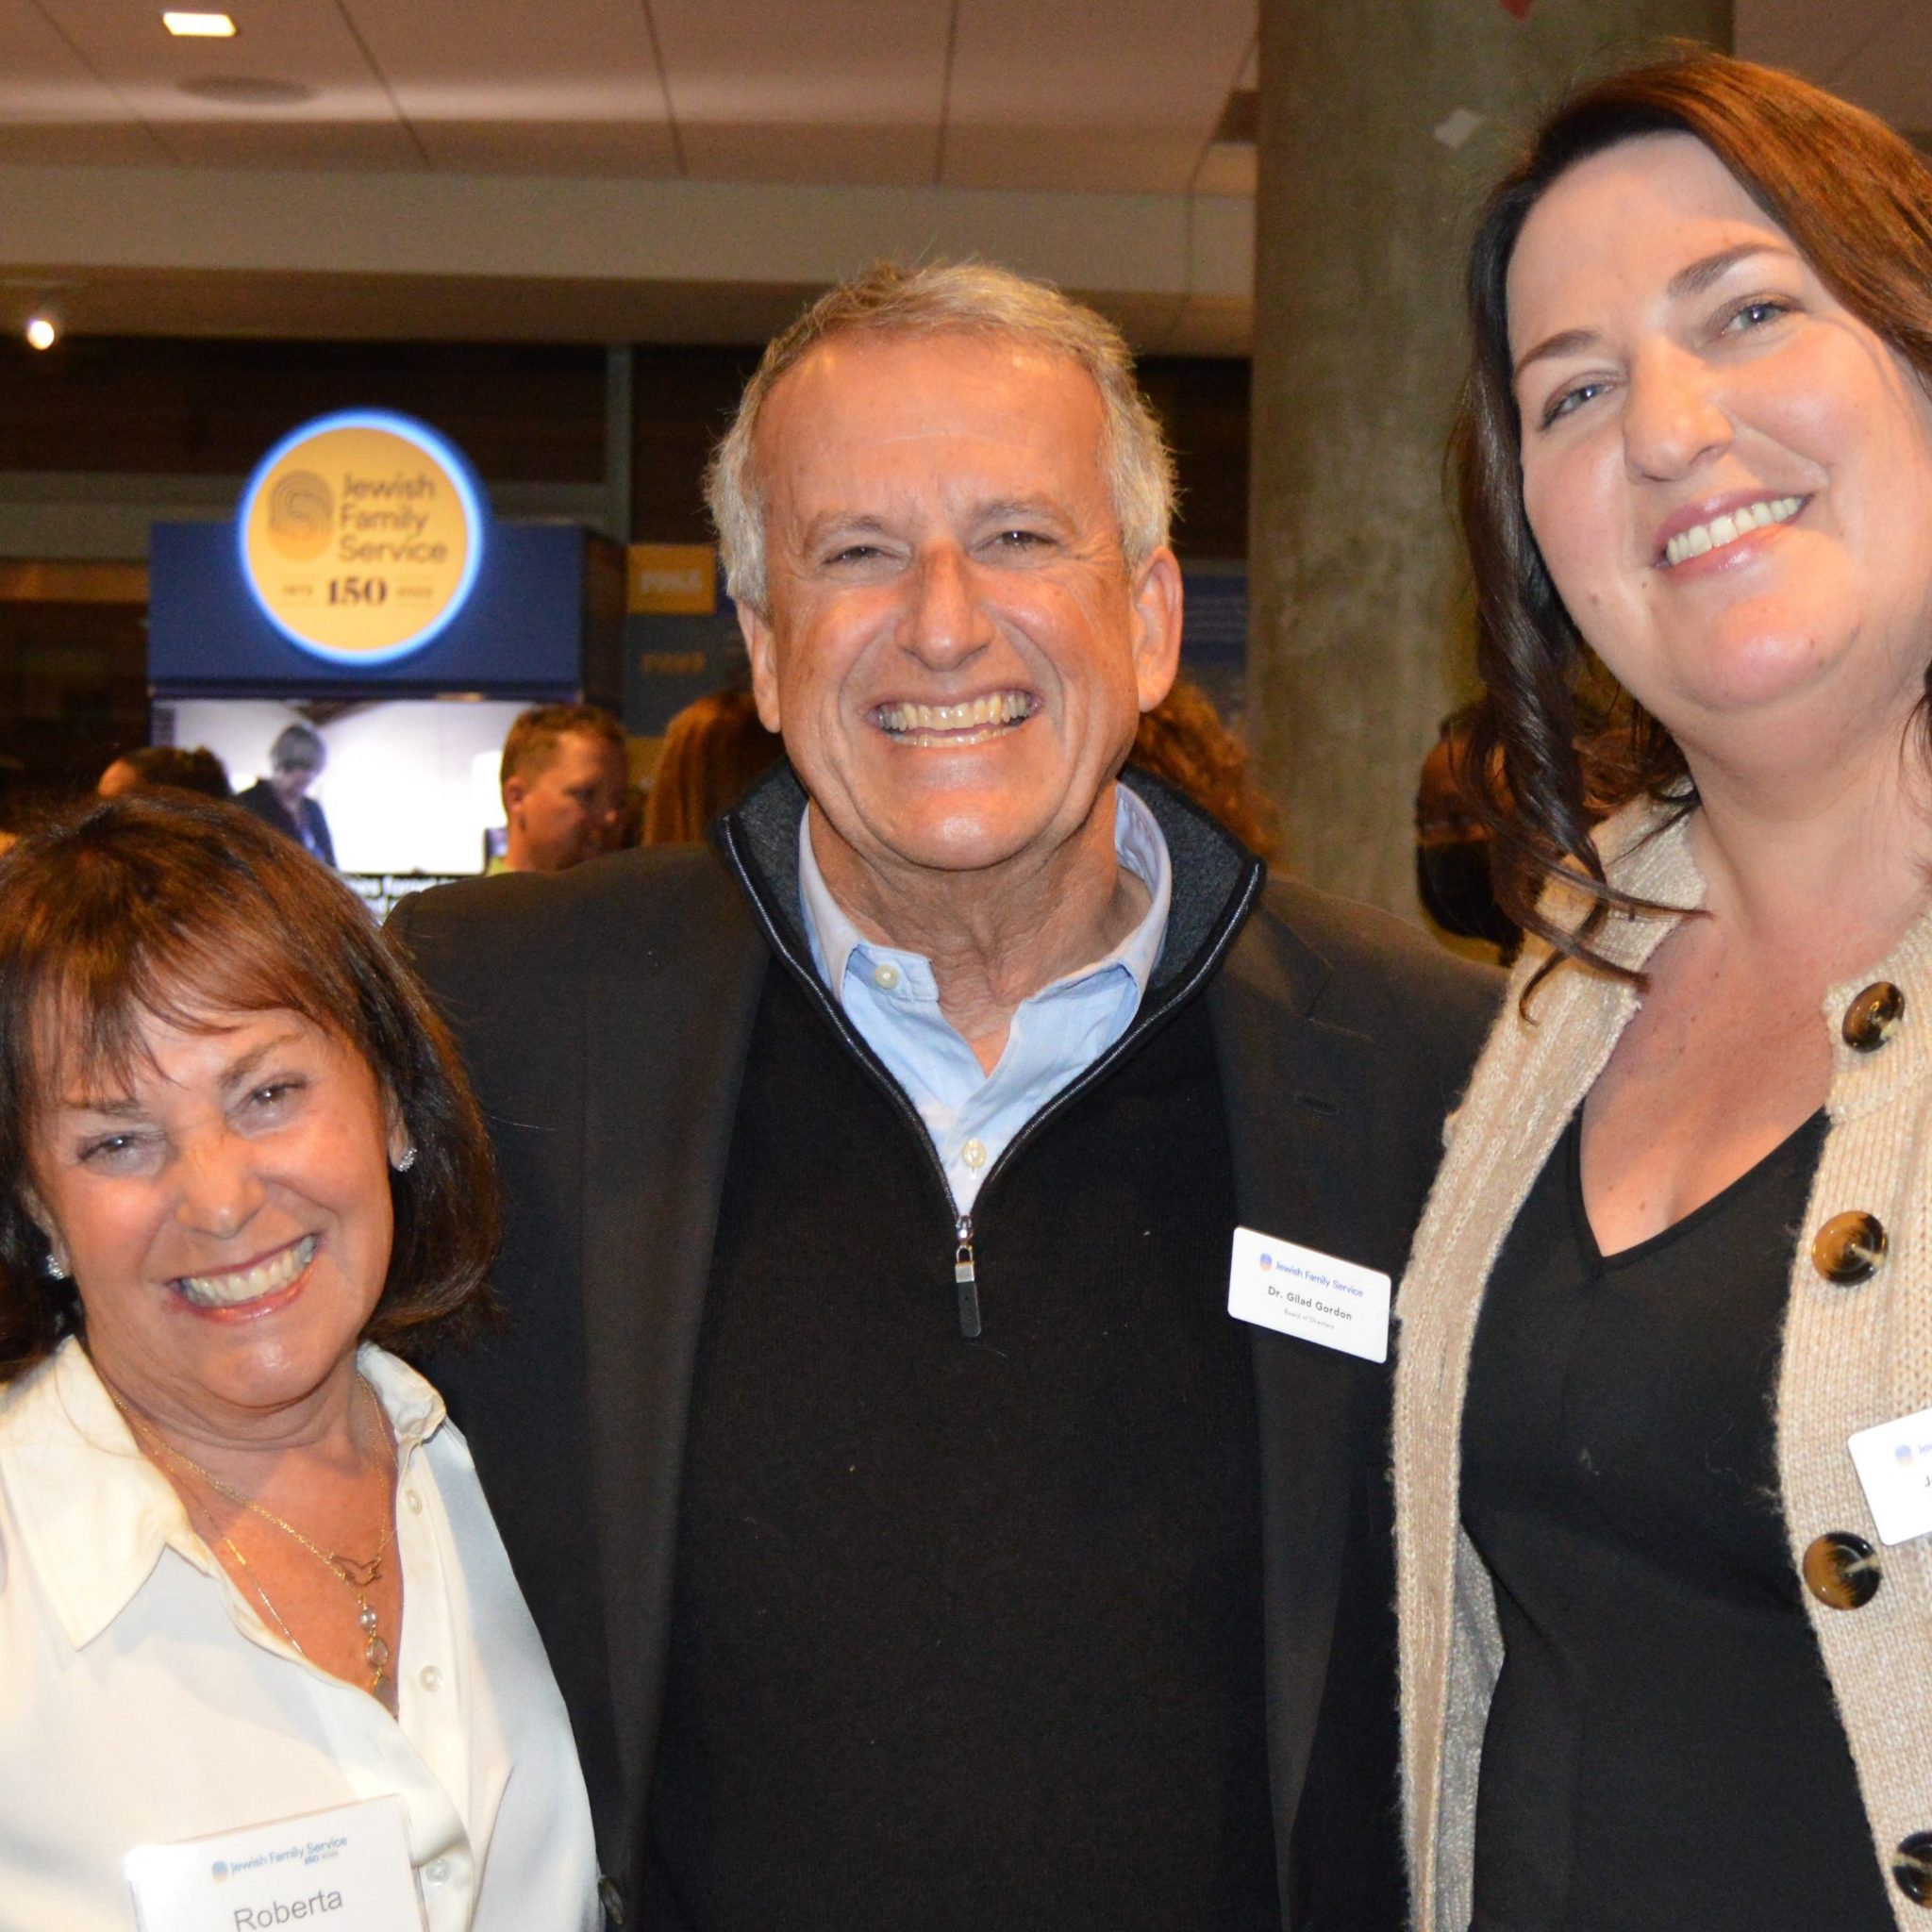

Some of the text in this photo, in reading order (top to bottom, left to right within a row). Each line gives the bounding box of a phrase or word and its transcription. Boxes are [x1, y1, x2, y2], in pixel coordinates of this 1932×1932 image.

[343, 473, 436, 501] Jewish
[341, 502, 429, 536] Family
[340, 535, 448, 563] Service
[328, 575, 388, 606] 150
[1275, 1261, 1363, 1297] Jewish Family Service
[1268, 1286, 1352, 1321] Dr. Gilad Gordon
[231, 1856, 268, 1875] Jewish
[270, 1845, 305, 1864] Family
[307, 1836, 347, 1855] Service
[233, 1889, 343, 1932] Roberta
